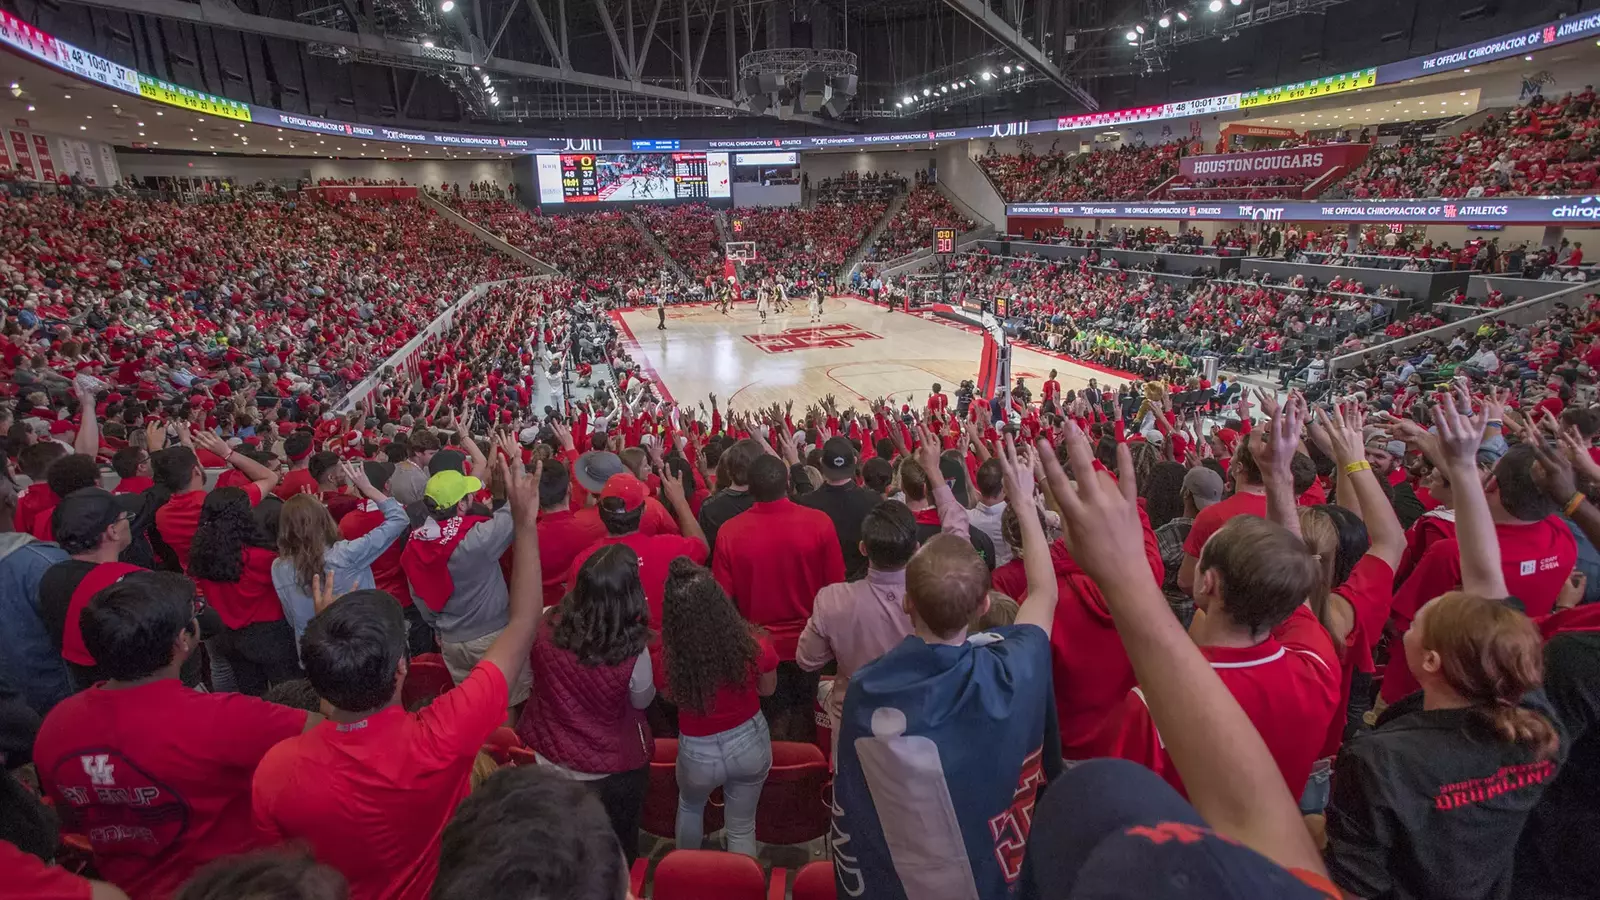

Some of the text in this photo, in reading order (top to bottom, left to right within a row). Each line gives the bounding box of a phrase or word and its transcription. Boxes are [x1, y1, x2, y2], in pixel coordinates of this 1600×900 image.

[1422, 60, 1436, 69] THE
[1436, 55, 1467, 66] OFFICIAL
[1468, 36, 1526, 58] CHIROPRACTOR
[1528, 32, 1540, 44] OF
[1556, 13, 1600, 37] ATHLETICS
[72, 49, 83, 65] 48
[88, 54, 111, 74] 10:01
[116, 67, 126, 80] 37
[1191, 98, 1211, 108] 10:01
[1217, 97, 1227, 105] 37
[280, 115, 288, 124] THE
[289, 117, 307, 126] OFFICIAL
[307, 120, 338, 131] CHIROPRACTOR
[353, 127, 373, 135] ATHLETICS
[1194, 153, 1323, 174] HOUSTON COUGARS
[1239, 206, 1252, 216] THE
[1366, 207, 1426, 215] CHIROPRACTOR
[1428, 207, 1440, 215] OF
[1459, 206, 1508, 214] ATHLETICS
[938, 239, 951, 251] 30
[1540, 561, 1559, 571] CREW
[81, 754, 115, 785] UH
